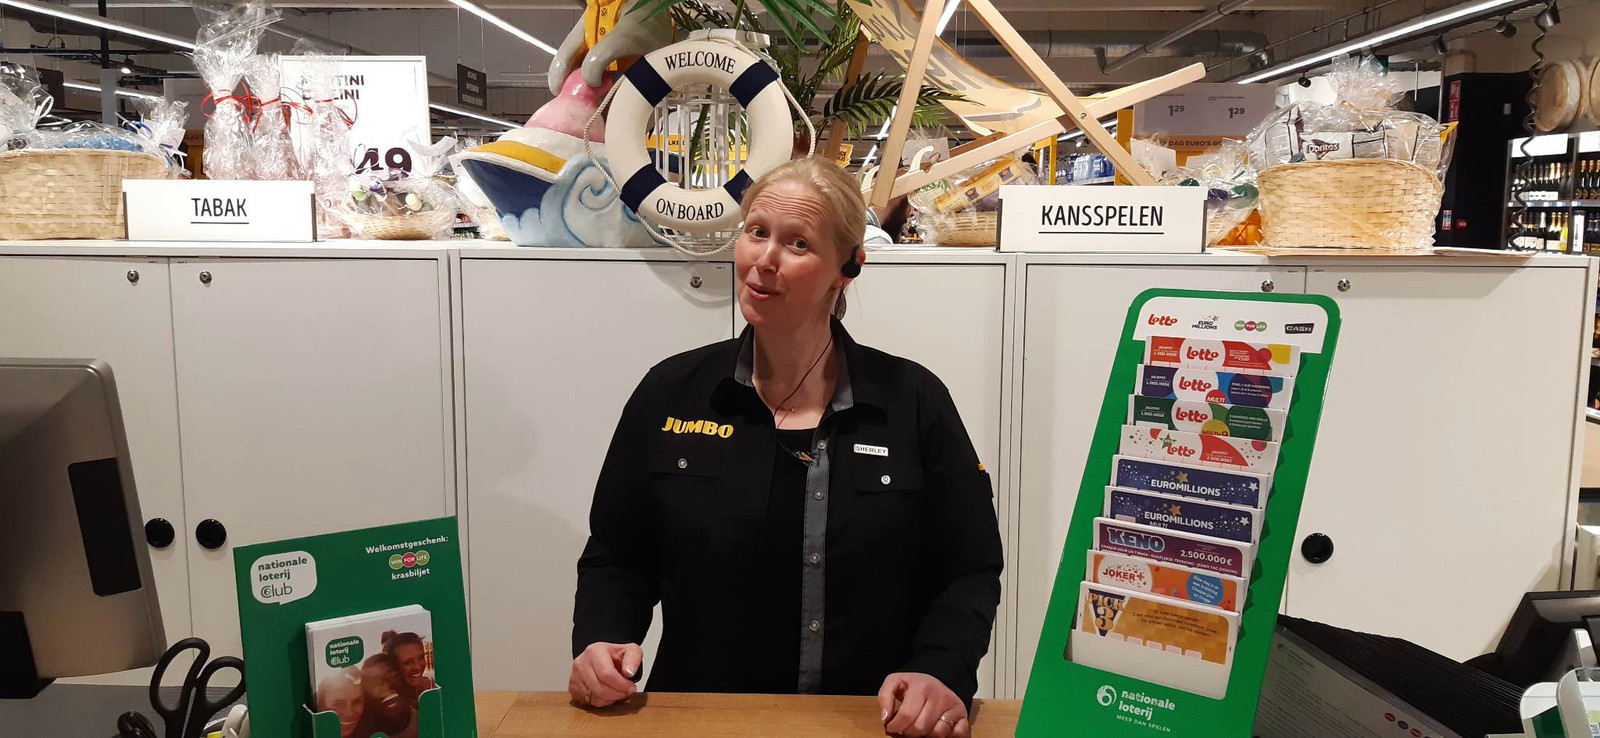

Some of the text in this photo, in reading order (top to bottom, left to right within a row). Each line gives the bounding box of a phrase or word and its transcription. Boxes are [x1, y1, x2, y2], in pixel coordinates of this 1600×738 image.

[664, 50, 736, 74] WELCOME
[1307, 142, 1339, 152] Doritos
[191, 197, 247, 217] TABAK
[656, 198, 724, 221] ON BOARD
[1040, 204, 1164, 228] KANSSPELEN
[1148, 313, 1178, 327] Lotto
[1186, 346, 1219, 361] Lotto
[1178, 376, 1212, 392] Lotto
[1175, 407, 1209, 423] Lotto
[661, 416, 734, 439] JUMBO
[855, 445, 887, 455] SHERLEY
[1166, 443, 1196, 457] Lotto
[1151, 479, 1221, 497] EUROMILLIONS
[1144, 511, 1214, 530] EUROMILLIONS
[365, 535, 449, 555] Welkomstgeschenk:
[1107, 527, 1166, 552] KENO
[258, 556, 308, 571] nationale
[389, 558, 403, 566] WIN
[259, 569, 291, 582] loterij
[391, 567, 430, 581] krasbiljet
[1086, 592, 1126, 611] PICK
[1095, 606, 1114, 630] 3
[329, 638, 360, 649] nationale
[329, 647, 349, 655] loterij
[1121, 688, 1176, 711] nationale
[1118, 701, 1154, 720] loterij
[1116, 714, 1171, 733] MEER DAN SPELEN
